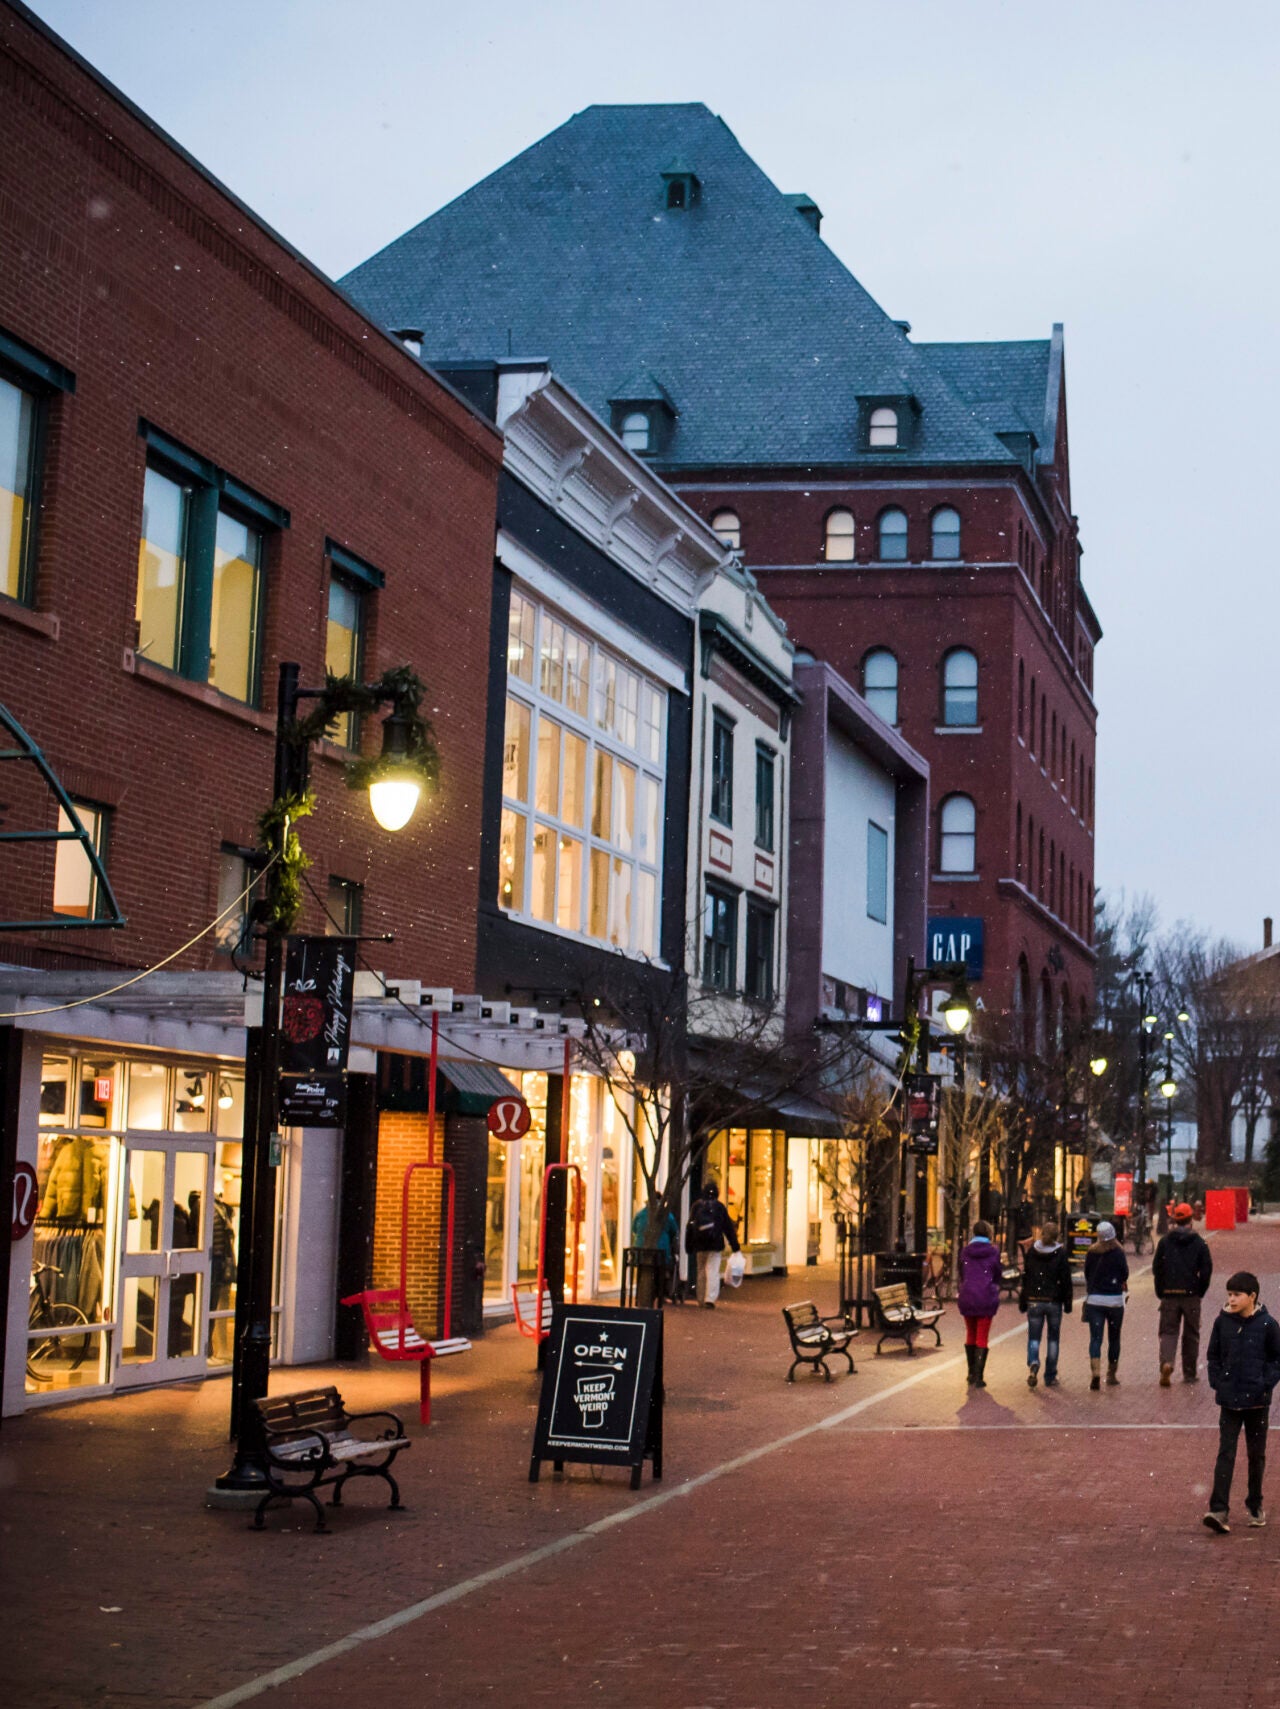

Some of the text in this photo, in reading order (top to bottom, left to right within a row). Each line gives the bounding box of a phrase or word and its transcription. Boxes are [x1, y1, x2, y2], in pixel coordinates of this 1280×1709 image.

[932, 933, 971, 962] GAP
[324, 953, 351, 1046] Happy Holidays
[574, 1344, 627, 1360] OPEN
[583, 1382, 606, 1393] KEEP
[573, 1391, 616, 1403] VERMONT
[579, 1401, 609, 1412] WEIRD
[547, 1440, 630, 1452] KEEPVERMONTWEIRD.COM
